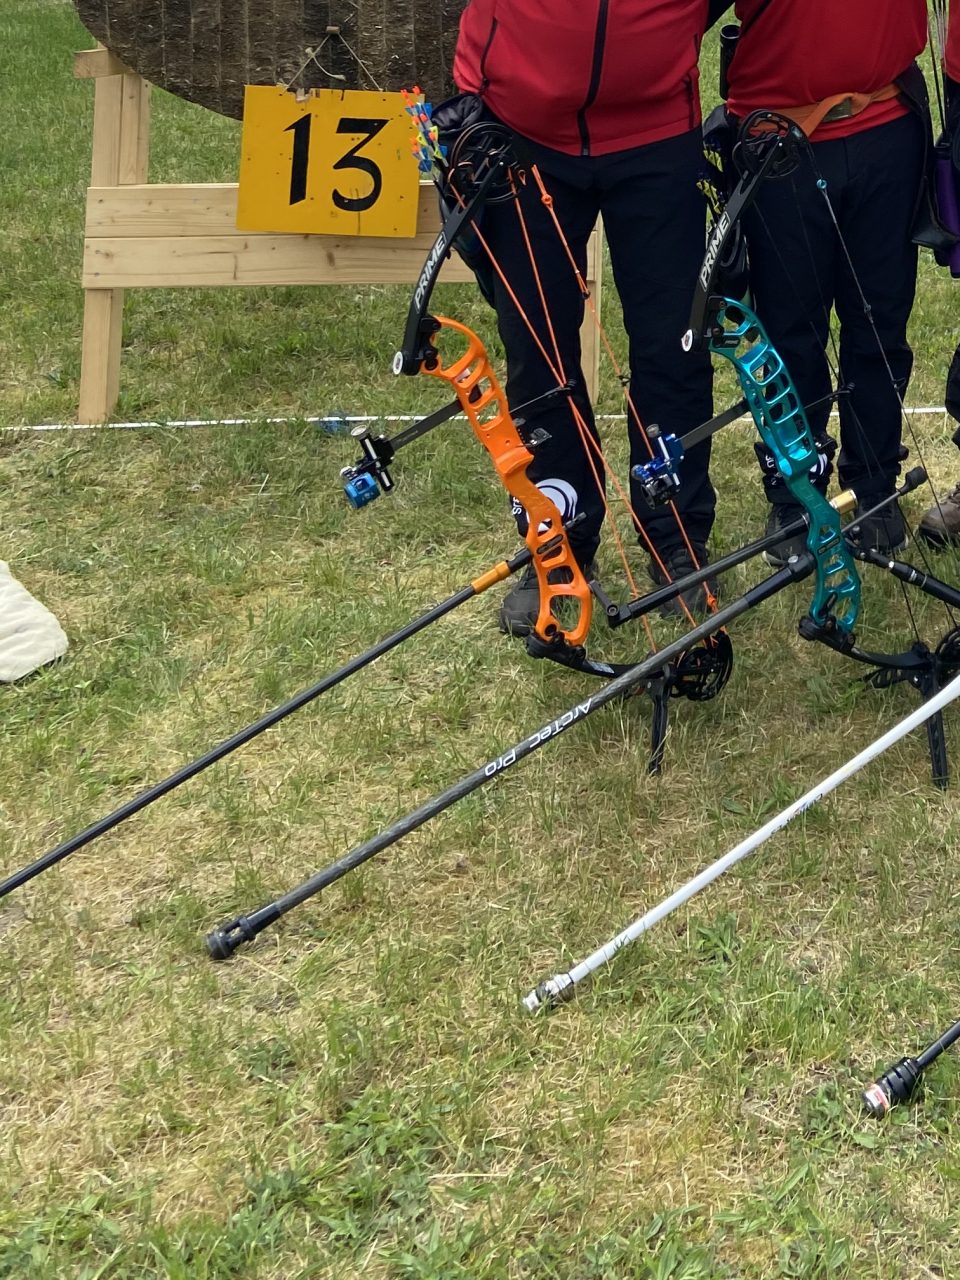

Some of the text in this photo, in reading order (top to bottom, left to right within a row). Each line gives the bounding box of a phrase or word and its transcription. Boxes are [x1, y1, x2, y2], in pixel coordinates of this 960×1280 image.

[283, 113, 391, 212] 13
[415, 235, 445, 309] PRIME
[701, 214, 729, 288] PRIME
[484, 698, 592, 777] ArcTec Pro
